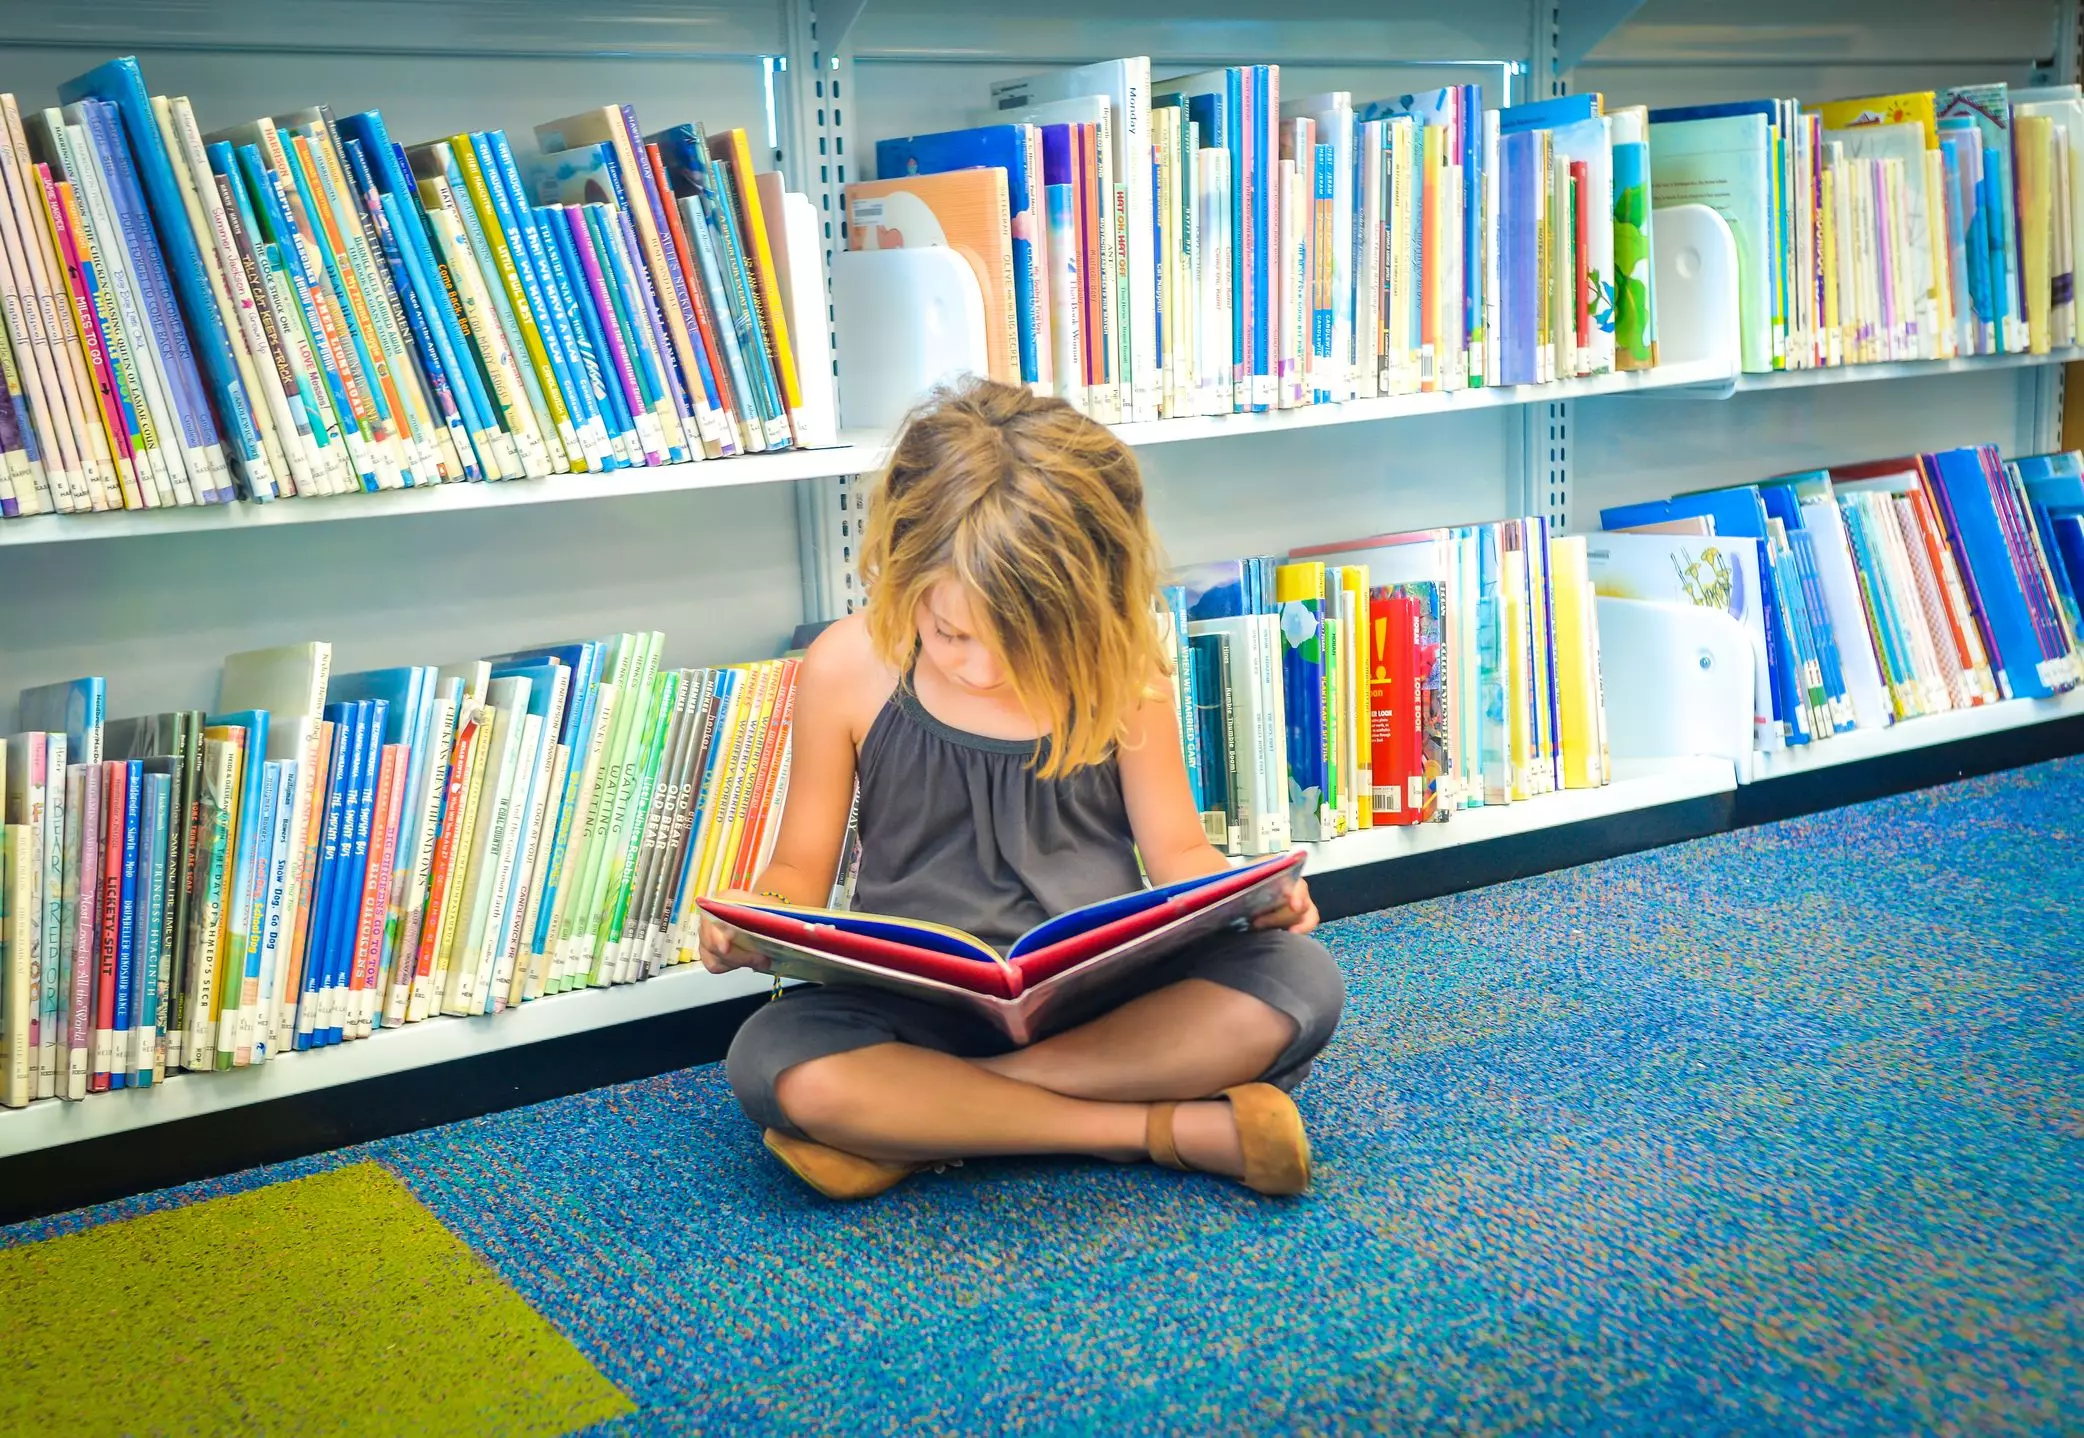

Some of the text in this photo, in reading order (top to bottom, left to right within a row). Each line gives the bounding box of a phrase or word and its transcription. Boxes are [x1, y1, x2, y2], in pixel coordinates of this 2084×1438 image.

[1126, 86, 1138, 135] Monday
[261, 126, 291, 178] HARRISON
[42, 175, 65, 232] JAMIE HARPER
[1115, 190, 1124, 214] HAT
[82, 222, 95, 242] THE
[134, 210, 153, 243] DON'T
[210, 205, 248, 295] Summer Jackson
[1117, 234, 1125, 256] HAT
[145, 245, 165, 283] FORGET
[358, 208, 414, 346] A LITTLE EXCITEMENT
[537, 222, 576, 304] TREASURE NAP
[1118, 258, 1126, 278] OFF
[119, 210, 173, 361] DON'T FORGET TO COME BACK!
[157, 285, 170, 299] TO
[254, 241, 291, 334] THE CLOCK STRUCK ONE
[325, 263, 358, 339] DEAR BEAR
[436, 261, 455, 291] Come
[457, 317, 472, 337] Ben
[74, 294, 103, 366] MILES TO GO
[161, 300, 179, 329] COME
[240, 253, 293, 385] TALLY CAT KEEPS TRACK
[115, 336, 132, 370] QUEEN
[312, 291, 335, 336] WHEN
[328, 336, 350, 377] LIONS
[343, 378, 364, 417] ROAR
[126, 372, 137, 385] OF
[130, 386, 147, 420] LAMAR
[1178, 608, 1188, 635] HINES
[645, 653, 659, 687] HENKES
[1180, 645, 1190, 675] WHEN
[1222, 645, 1230, 664] Hines
[630, 655, 643, 689] HENKES
[675, 679, 689, 712] HENKES
[686, 680, 700, 714] HENKES
[700, 680, 714, 714] HENKES
[438, 706, 456, 760] CHICKENS
[542, 675, 568, 772] HENDERSON HOWARD
[591, 706, 610, 754] HENKES
[701, 714, 716, 751] henkes
[1183, 696, 1194, 741] MARRIED
[1413, 704, 1421, 732] BOOK
[715, 718, 746, 823] WEMBERLY WORRIED
[726, 718, 757, 823] WEMBERLY WORRIED
[737, 714, 769, 819] WEMBERLY WORRIED
[1186, 743, 1195, 768] GARY
[427, 804, 439, 825] THE
[596, 763, 620, 837] WAITING
[610, 761, 636, 834] WAITING
[644, 781, 668, 848] OLD BEAR
[324, 790, 343, 860] THE SMUSHY BUS
[340, 787, 358, 857] THE SMUSHY BUS
[354, 786, 373, 855] THE SMUSHY BUS
[496, 806, 507, 825] COAL
[655, 783, 678, 850] OLD BEAR
[669, 782, 692, 848] OLD BEAR
[681, 809, 695, 830] egg
[384, 826, 394, 848] BIG
[421, 828, 435, 856] ONLY
[490, 825, 504, 856] COUNTRY
[525, 802, 544, 865] LOOK AT YOU!
[214, 846, 225, 868] THE
[273, 858, 286, 883] Snow
[416, 856, 430, 886] ONES
[212, 873, 222, 896] DAY
[374, 851, 391, 915] CHICKENS
[79, 892, 93, 920] Most
[209, 901, 219, 915] OF
[268, 913, 280, 926] Go
[356, 862, 378, 977] BIG CHICKENS
[509, 885, 527, 944] CANDLEWICK
[77, 922, 91, 954] Loved
[102, 876, 117, 975] LICKETY-SPLIT
[146, 862, 162, 995] PRINCESS HYACINTH
[266, 930, 278, 950] Dog
[372, 918, 382, 935] GO
[77, 956, 90, 968] in
[117, 899, 132, 1015] DRUMHELLER DINOSAUR DANCE
[203, 921, 217, 975] AHMED'S
[369, 938, 379, 955] TO
[76, 970, 89, 987] All
[73, 1006, 87, 1041] World
